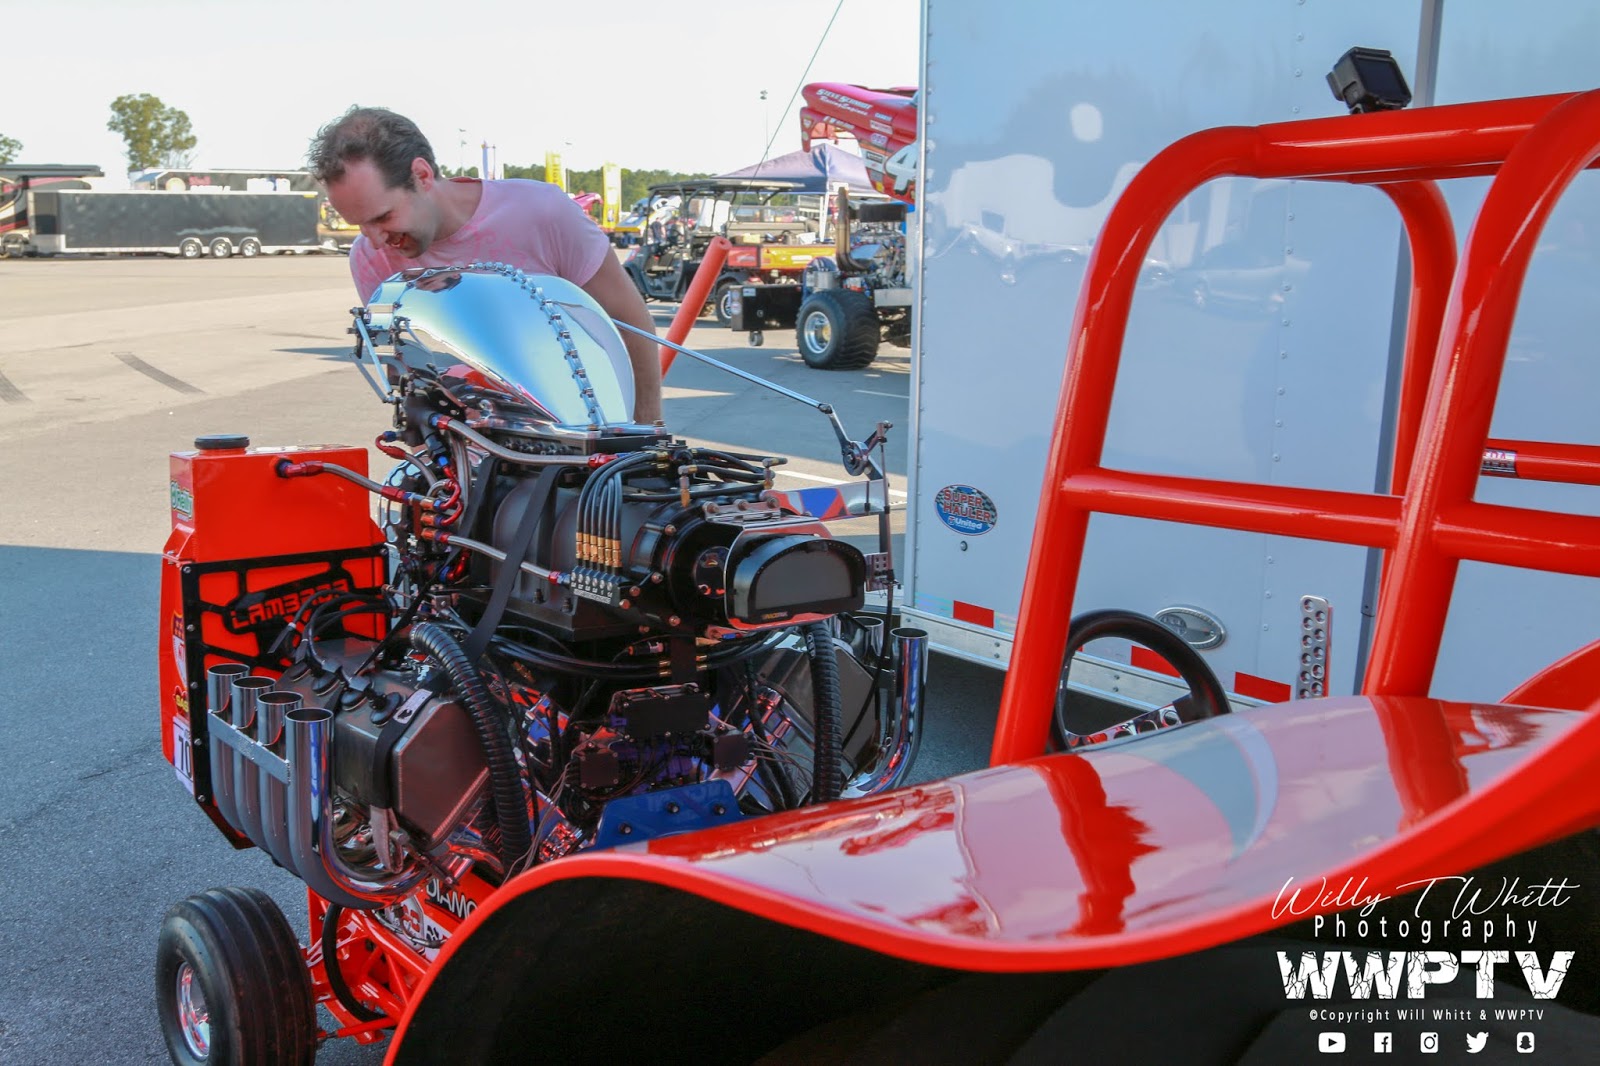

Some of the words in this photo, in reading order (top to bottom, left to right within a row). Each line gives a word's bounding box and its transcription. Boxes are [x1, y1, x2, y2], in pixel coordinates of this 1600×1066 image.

[943, 489, 983, 507] SUPER
[943, 501, 991, 521] HAULER
[955, 517, 983, 530] United
